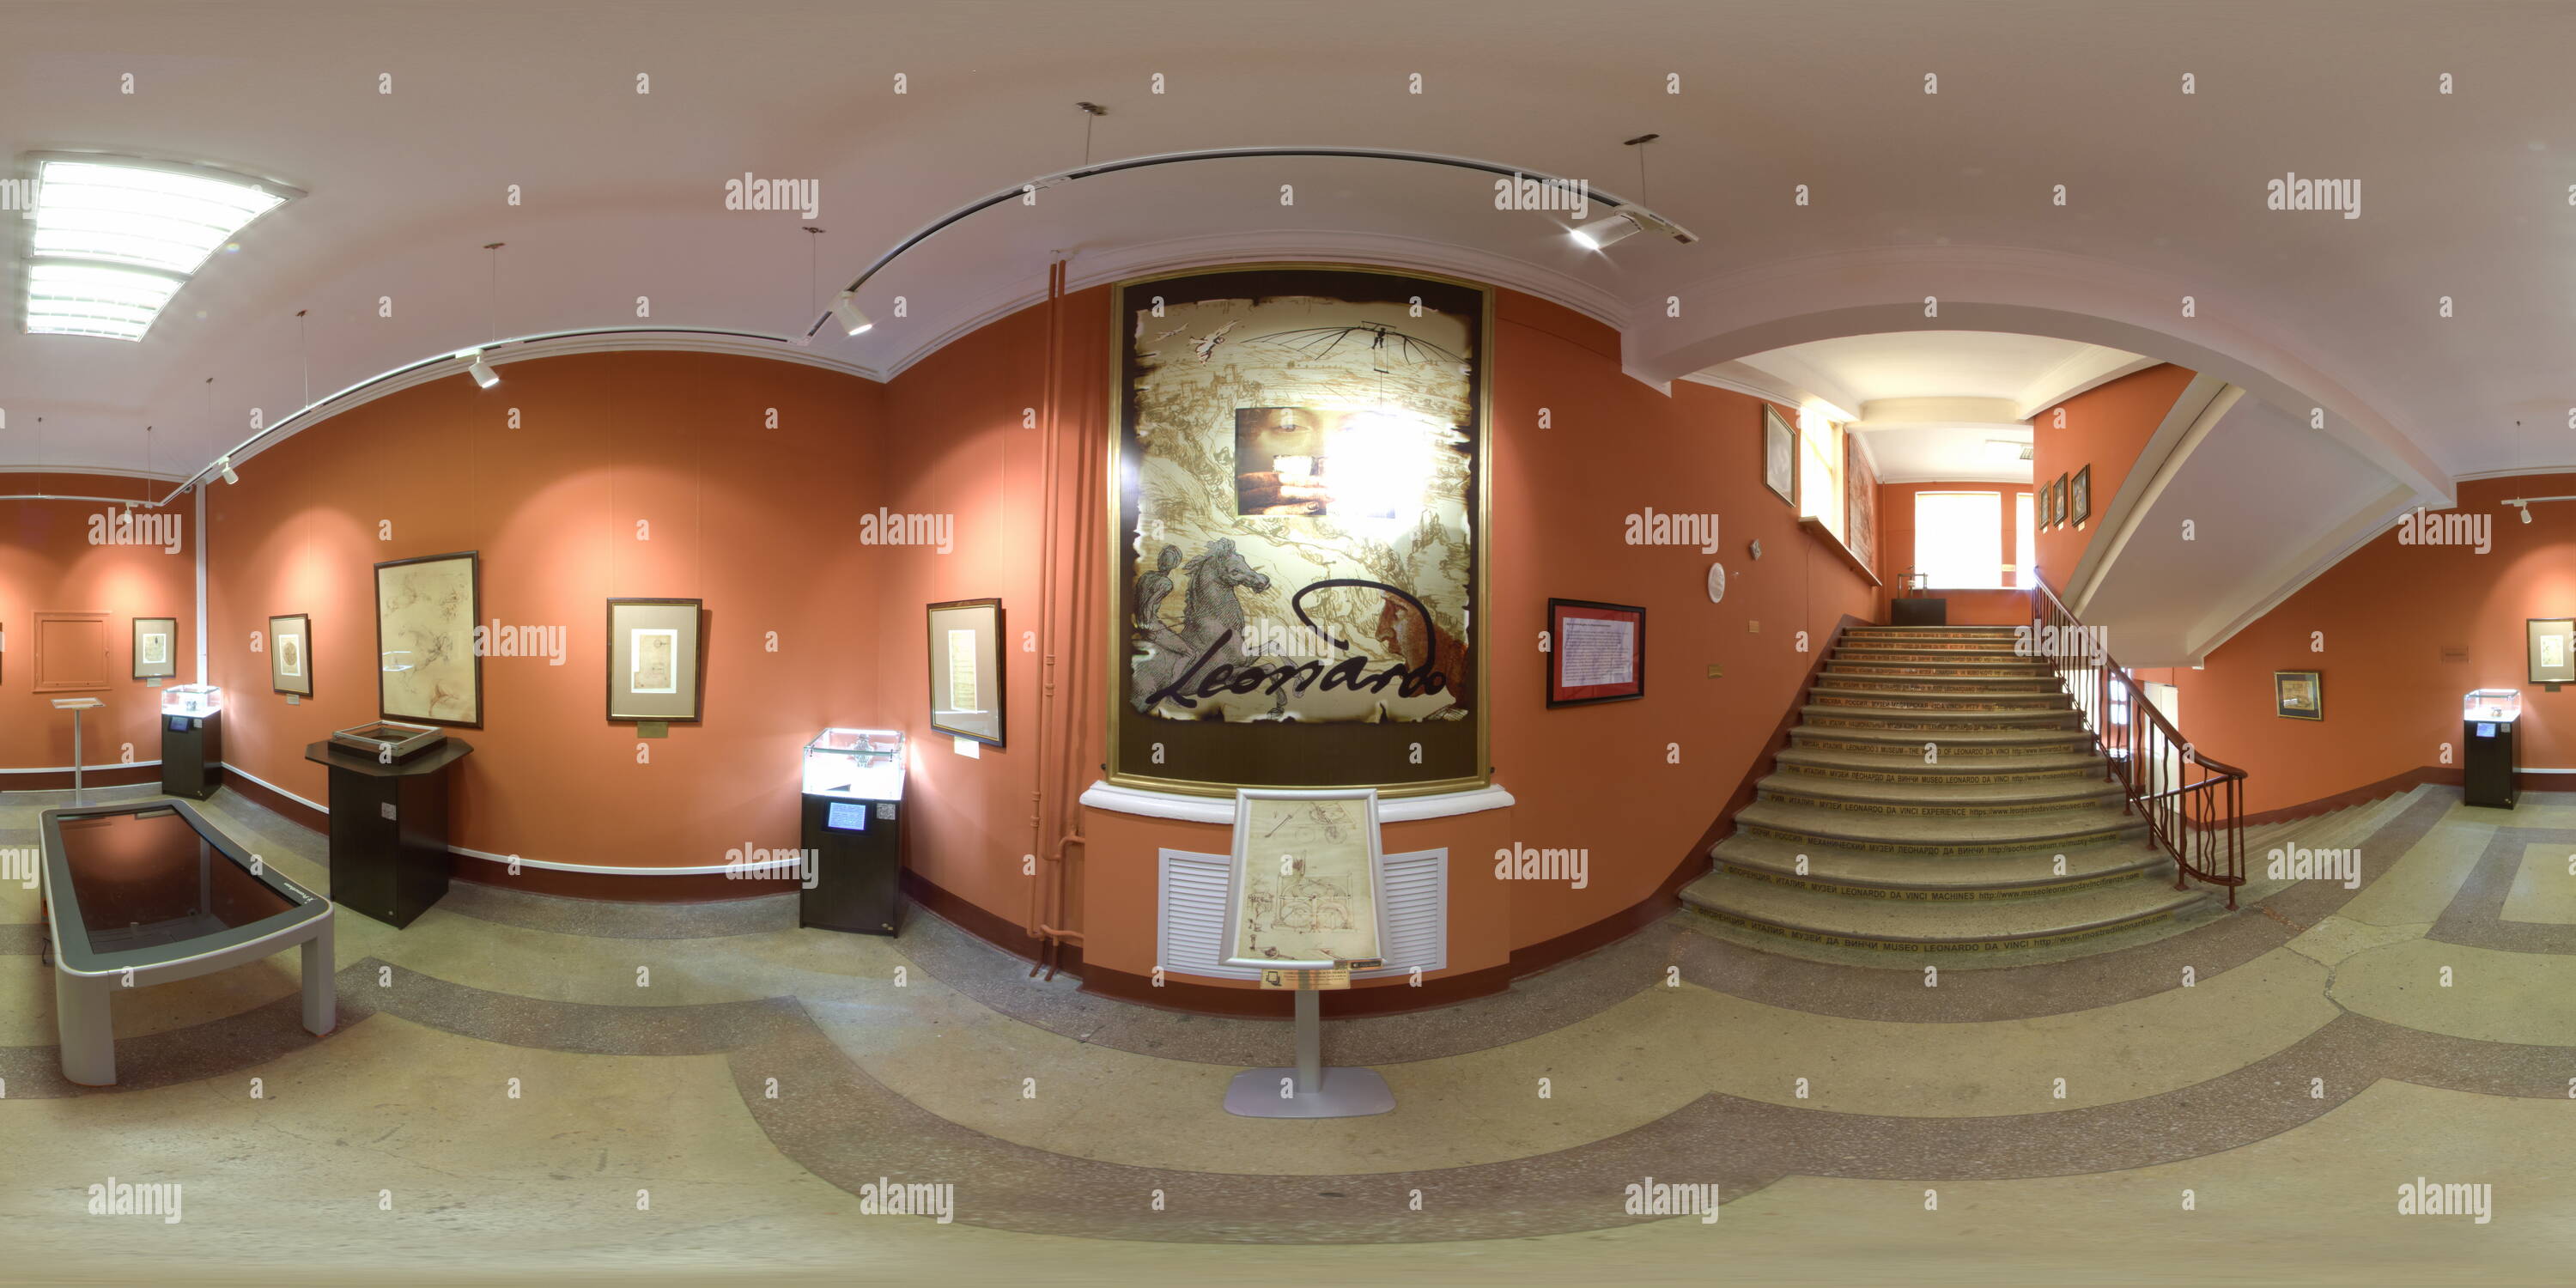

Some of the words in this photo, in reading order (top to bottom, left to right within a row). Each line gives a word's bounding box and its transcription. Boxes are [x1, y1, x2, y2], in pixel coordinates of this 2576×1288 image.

[1145, 578, 1447, 709] Leonardo
[1898, 775, 1918, 783] ВИНЧИ
[1845, 803, 1883, 813] LEONARDO
[1897, 845, 1939, 855] ЛЕОНАРДО
[1942, 846, 1954, 856] ДА
[1958, 846, 1984, 855] ВИНЧИ
[1841, 885, 1886, 899] LEONARDO
[1890, 891, 1901, 900] DA
[1905, 892, 1928, 901] VINCI
[1931, 892, 1975, 901] MACHINES
[1791, 930, 1821, 944] МУЗЕЙ
[1826, 934, 1839, 945] ДА
[1844, 939, 1879, 951] ВИНЧИ
[1883, 943, 1918, 952] MUSEO
[1923, 944, 1979, 953] LEONARDO
[1984, 942, 1998, 951] DA
[2004, 940, 2029, 949] VINCI
